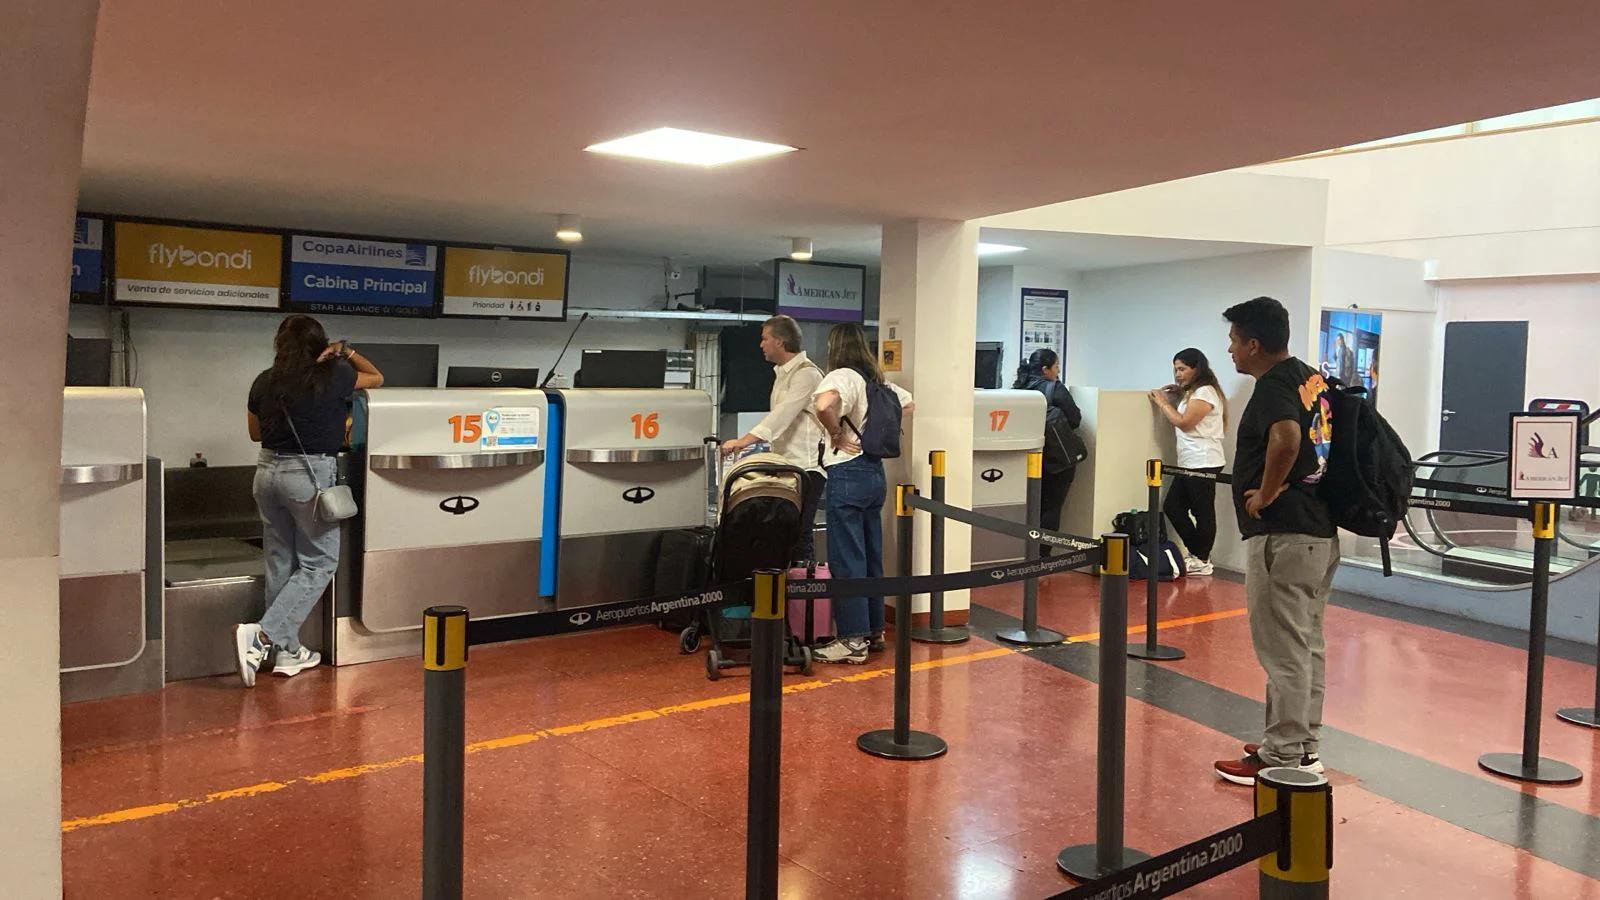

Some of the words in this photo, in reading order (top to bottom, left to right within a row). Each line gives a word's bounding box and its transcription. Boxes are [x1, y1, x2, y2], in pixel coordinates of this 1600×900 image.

[148, 243, 252, 269] flybondi
[303, 274, 359, 290] Cabina
[363, 277, 427, 295] Principal
[468, 264, 544, 286] flybondi
[127, 283, 157, 294] Venta
[159, 284, 172, 294] de
[174, 286, 215, 297] servicios
[217, 289, 270, 299] adicionales
[310, 303, 334, 311] STAR
[336, 304, 381, 313] ALLIANCE
[472, 301, 505, 309] Prioridad
[448, 415, 481, 444] 15
[631, 412, 660, 439] 16
[990, 410, 1009, 431] 17
[807, 582, 827, 593] 2000
[595, 604, 651, 623] Aeropuertos
[650, 594, 701, 614] Argentina
[700, 590, 723, 604] 2000
[1133, 851, 1209, 893] Argentina
[1209, 832, 1243, 863] 2000
